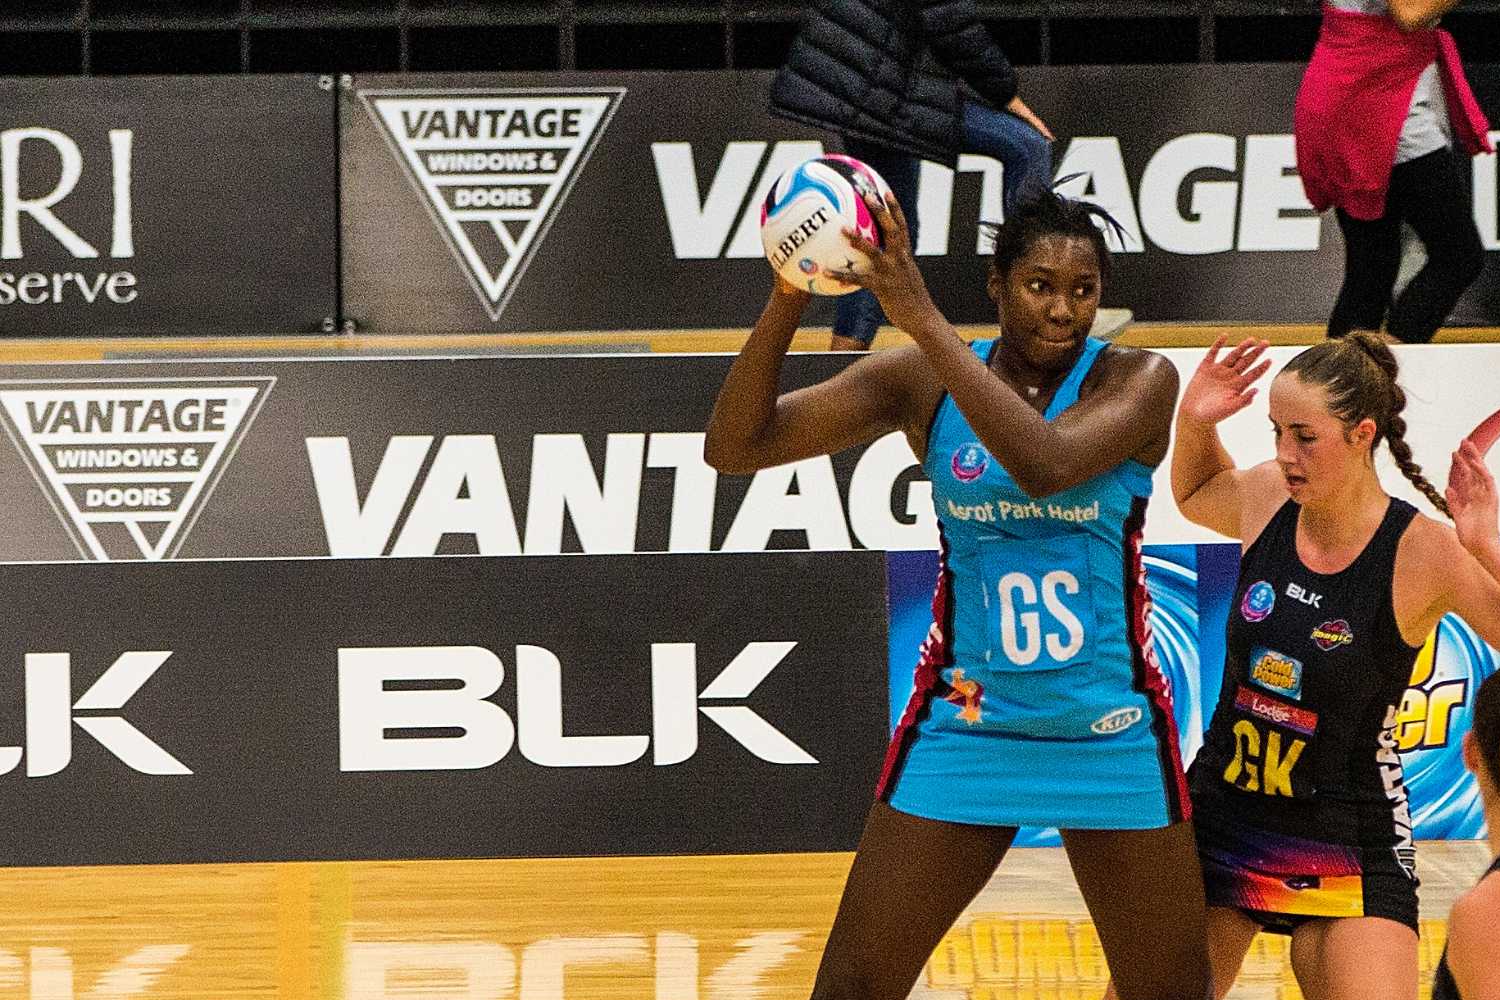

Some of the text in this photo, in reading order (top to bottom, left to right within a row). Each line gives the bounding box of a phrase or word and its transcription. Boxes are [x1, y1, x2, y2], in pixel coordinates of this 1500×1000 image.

[401, 108, 583, 140] VANTAGE
[428, 151, 557, 173] WINDOWS &
[454, 187, 532, 209] DOORS
[0, 269, 139, 305] serve
[25, 400, 227, 435] VANTAGE
[55, 447, 199, 470] WINDOWS &
[85, 485, 172, 508] DOORS
[305, 430, 938, 555] VANTAG
[1000, 500, 1043, 520] Park
[1285, 582, 1324, 609] BLK
[998, 571, 1084, 666] GS
[0, 650, 195, 779] K
[338, 641, 820, 773] BLK
